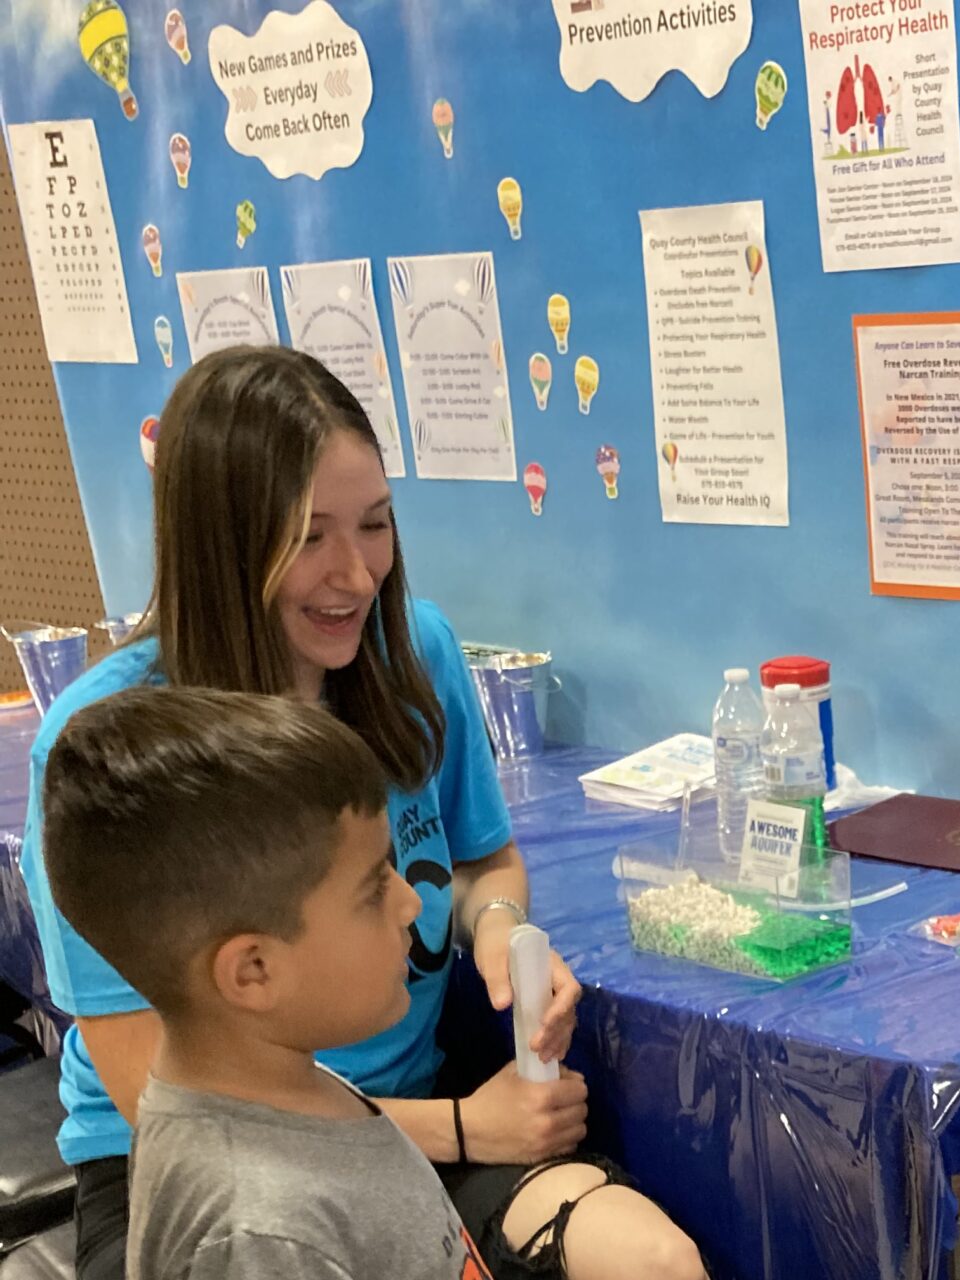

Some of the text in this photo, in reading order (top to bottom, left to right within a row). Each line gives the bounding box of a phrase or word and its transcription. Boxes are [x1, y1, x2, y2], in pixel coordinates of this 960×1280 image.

[831, 0, 884, 23] Protect
[568, 1, 736, 45] Prevention Activities
[809, 10, 949, 51] Respiratory Health
[219, 38, 357, 79] New Games and Prizes
[915, 53, 936, 64] Short
[903, 66, 949, 80] Presentation
[264, 80, 318, 106] Everyday
[912, 82, 942, 95] by Quay
[914, 97, 942, 108] County
[917, 110, 942, 122] Health
[245, 111, 350, 141] Come Back Often
[916, 124, 944, 136] Council
[45, 131, 67, 168] E
[832, 152, 945, 175] Free Gift for All Who Attend
[670, 237, 695, 248] County
[697, 235, 721, 245] Health
[723, 231, 748, 243] Council
[874, 342, 899, 352] Anyone
[901, 341, 914, 350] Can
[915, 341, 934, 350] Learn
[937, 341, 944, 349] to
[946, 340, 960, 348] Save
[884, 360, 901, 368] Free
[903, 359, 940, 368] Overdose
[899, 371, 928, 379] Narcan
[676, 494, 770, 509] Raise Your Health IQ
[750, 820, 798, 842] AWESOME
